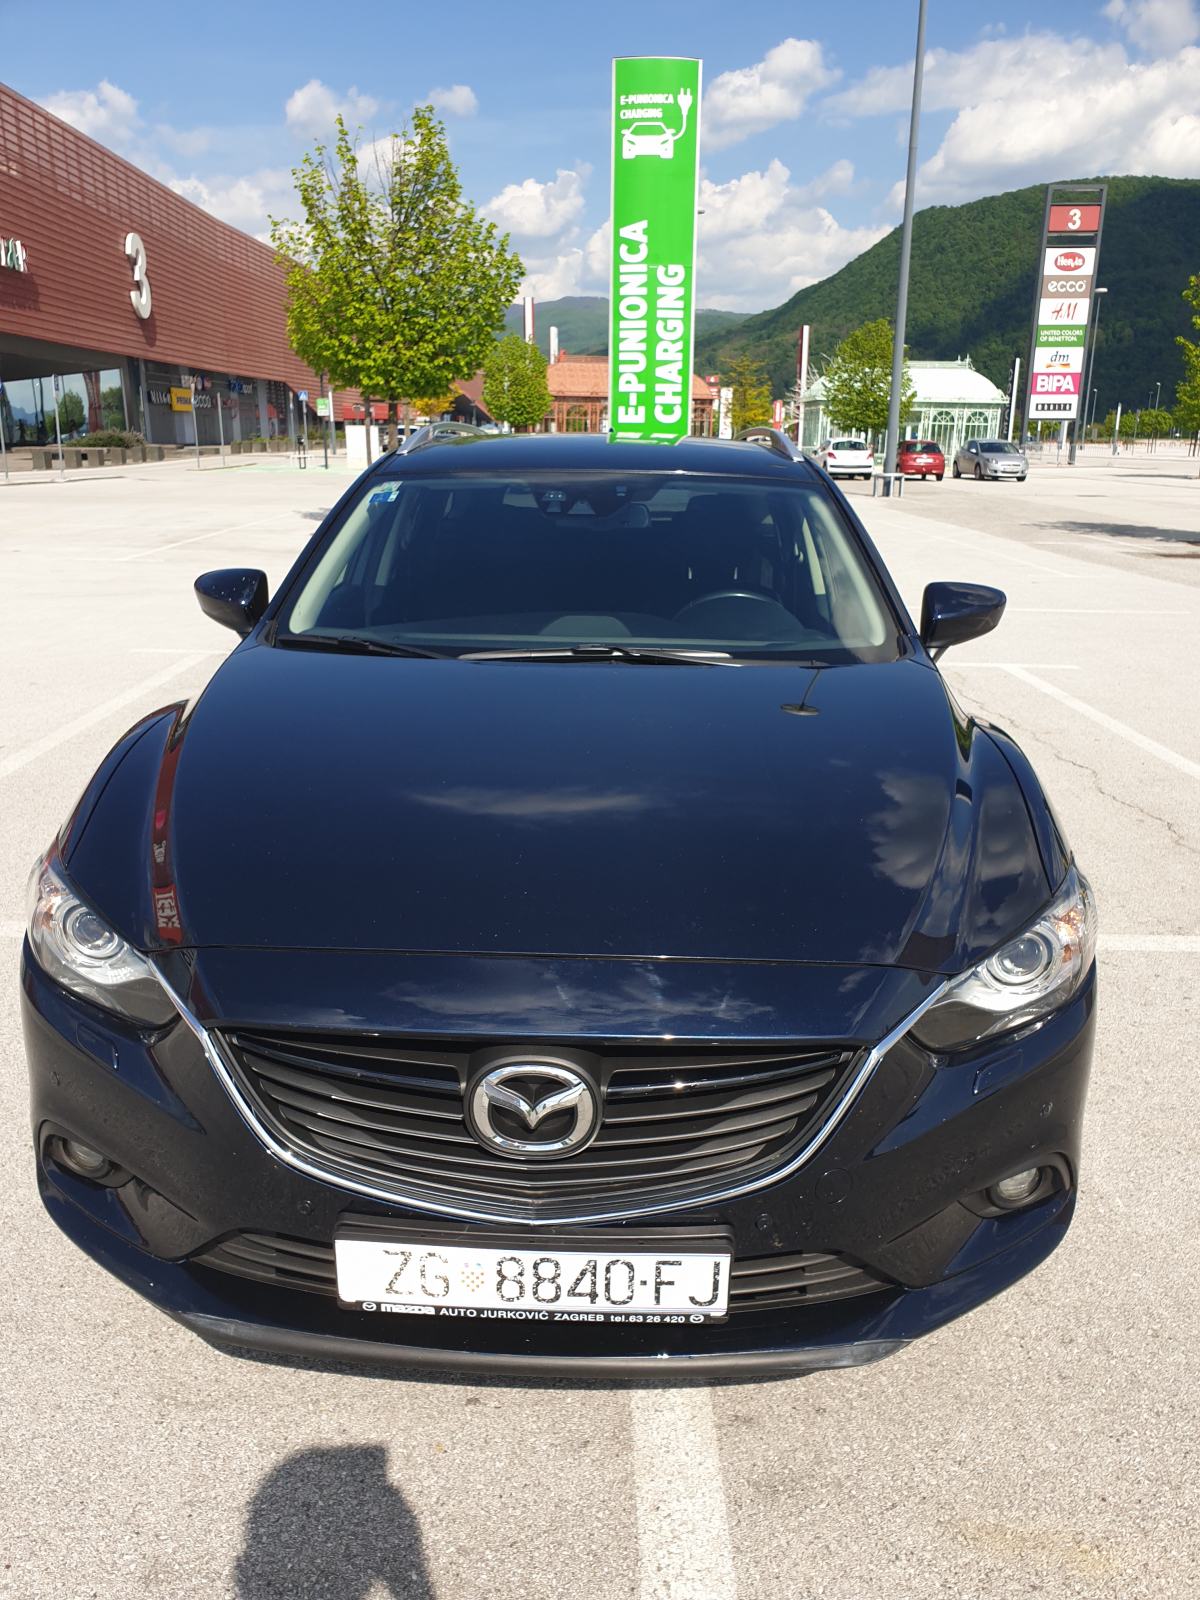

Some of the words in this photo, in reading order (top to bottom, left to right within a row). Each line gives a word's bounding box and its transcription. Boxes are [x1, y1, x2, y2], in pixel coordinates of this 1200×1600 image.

[1067, 208, 1081, 230] 3
[125, 232, 152, 319] 3
[1047, 280, 1086, 293] ecco
[618, 219, 649, 424] E-PUNIONICA
[654, 264, 686, 424] CHARGING
[1050, 351, 1069, 362] dm
[1036, 375, 1074, 392] BIPA
[383, 1249, 450, 1298] ZG
[380, 1303, 436, 1315] mazda
[439, 1307, 477, 1318] AUTO
[480, 1309, 549, 1321] JURKOVIĆ
[554, 1312, 605, 1322] ZAGREB
[646, 1315, 661, 1323] 26
[663, 1315, 686, 1324] 420
